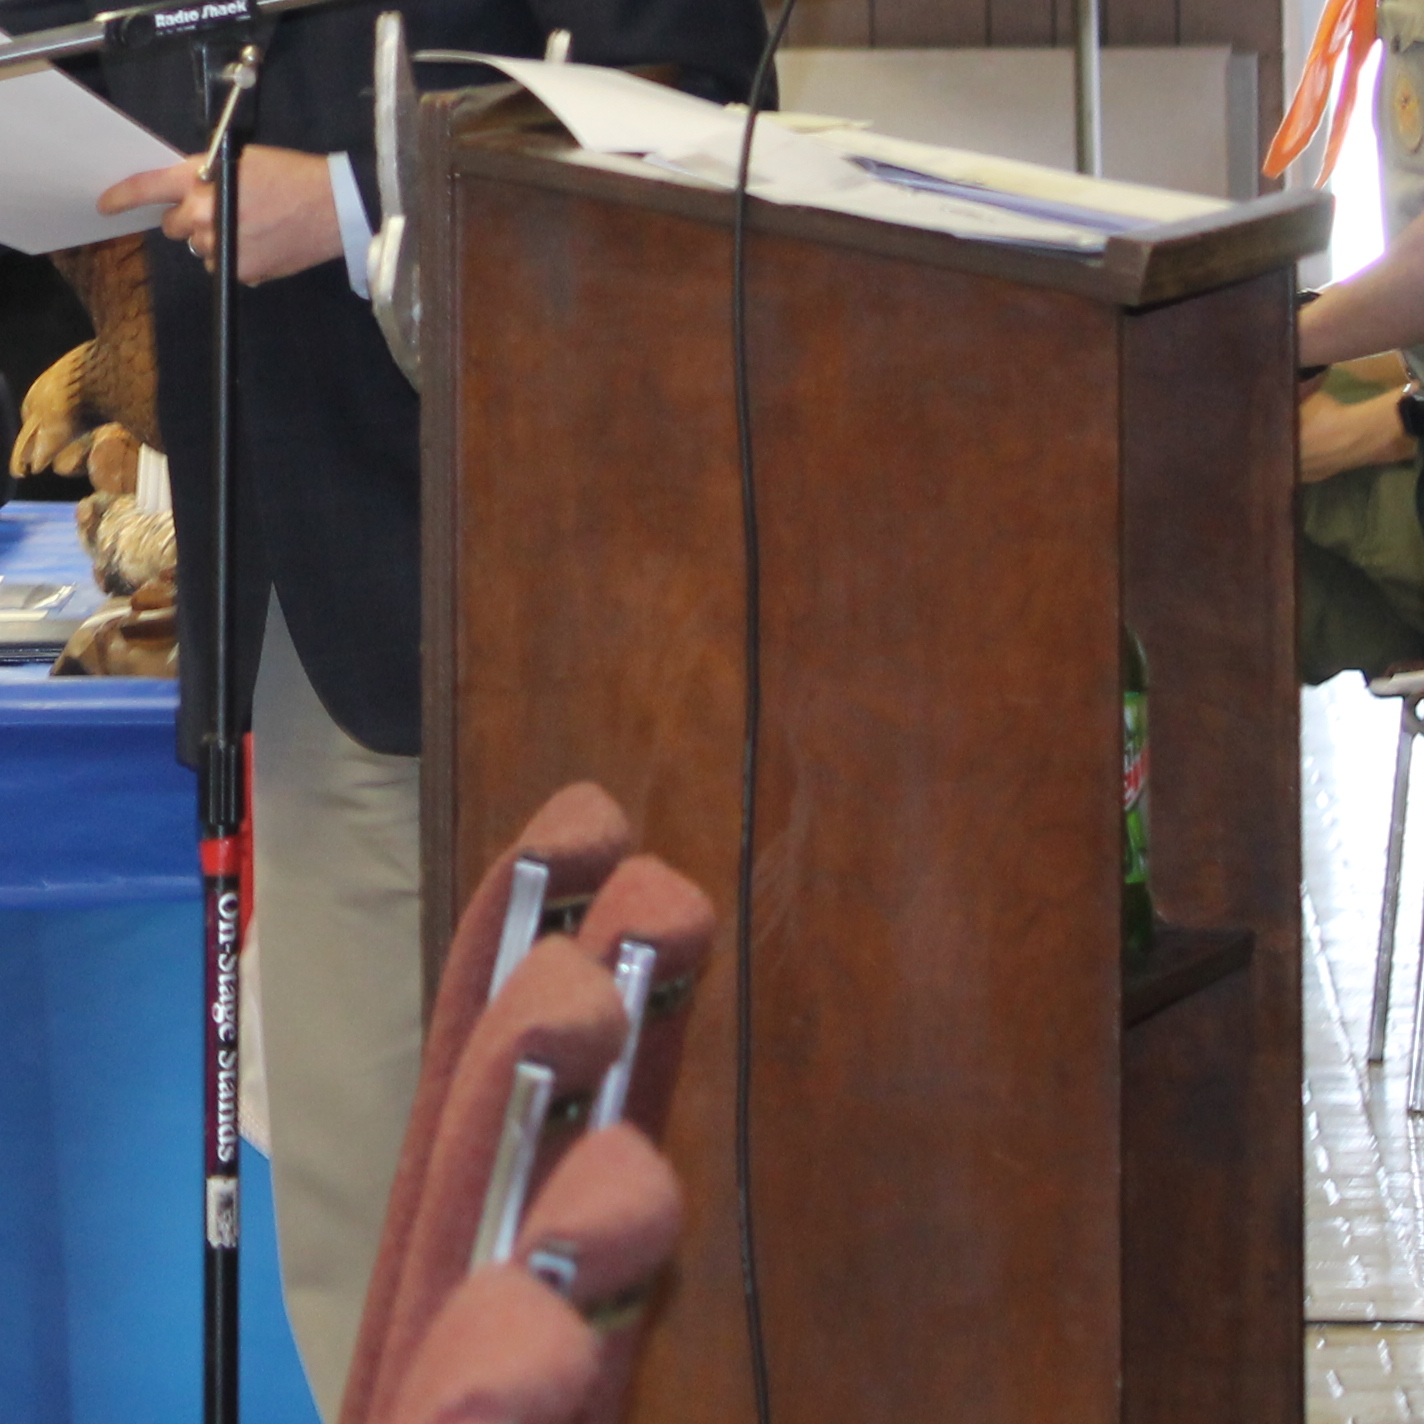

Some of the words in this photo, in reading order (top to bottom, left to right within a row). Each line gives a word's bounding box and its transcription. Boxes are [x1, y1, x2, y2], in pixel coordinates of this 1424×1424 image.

[155, 9, 199, 28] Radio
[212, 892, 239, 1042] On-Stage
[217, 1049, 238, 1163] Stands
